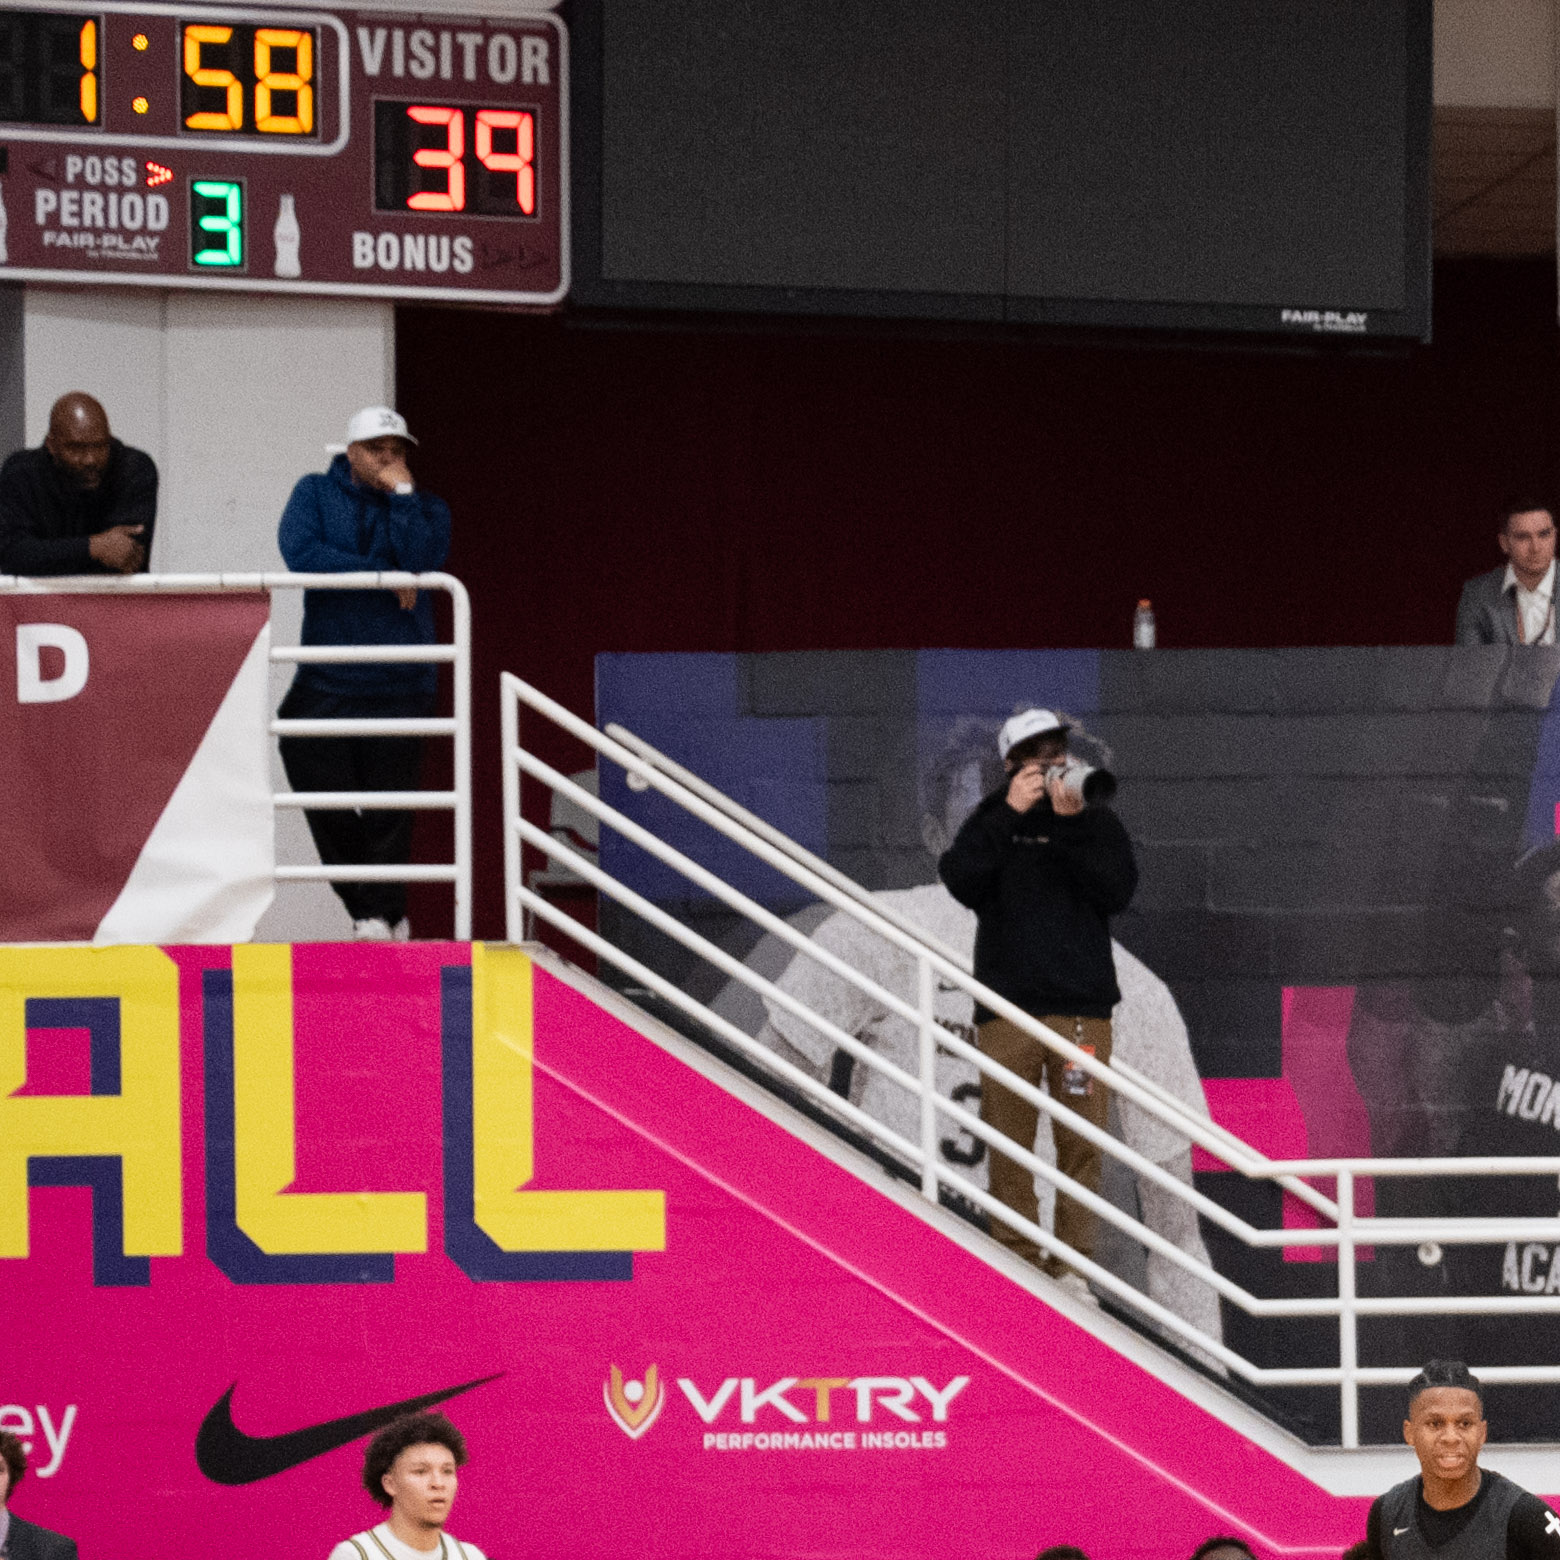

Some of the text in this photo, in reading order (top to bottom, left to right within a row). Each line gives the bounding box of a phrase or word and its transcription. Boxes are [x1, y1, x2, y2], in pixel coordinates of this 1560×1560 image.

[80, 20, 314, 133] 1:58
[357, 27, 551, 85] VISITOR
[65, 154, 138, 187] POSS
[406, 105, 534, 215] 39
[35, 188, 169, 231] PERIOD
[193, 181, 241, 265] 3
[353, 232, 474, 273] BONUS
[16, 623, 90, 703] D
[677, 1375, 970, 1423] VKTRY
[704, 1431, 946, 1450] PERFORMANCE INSOLES
